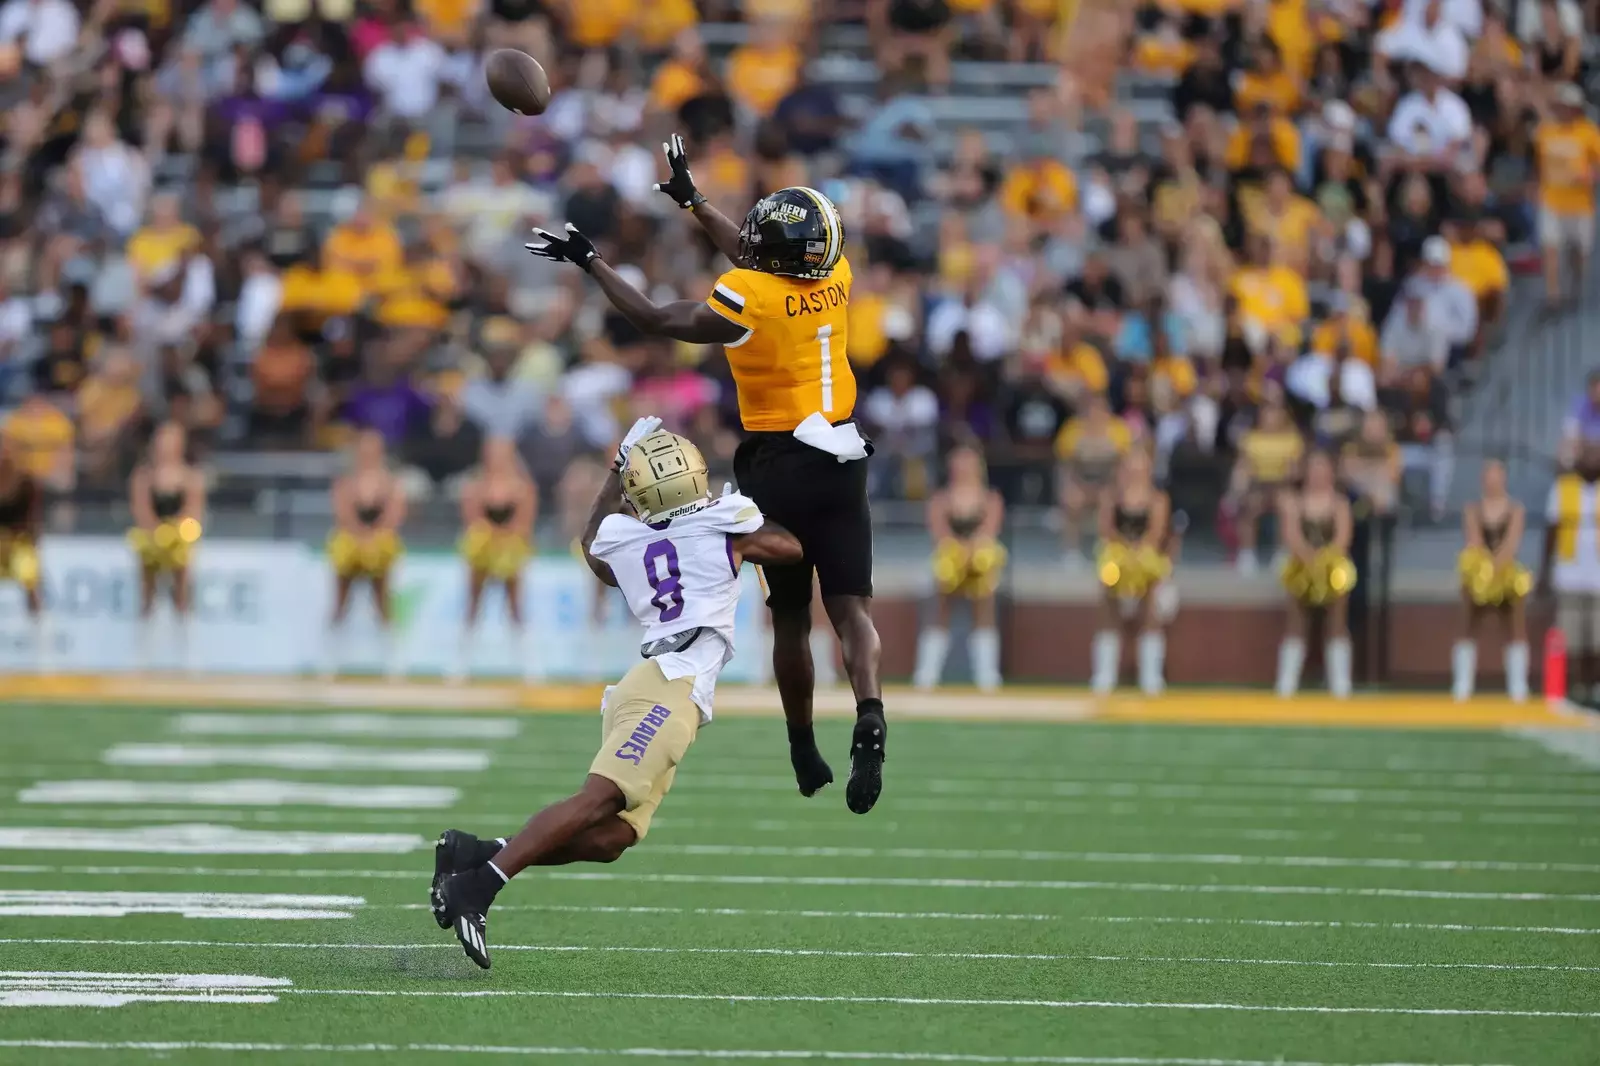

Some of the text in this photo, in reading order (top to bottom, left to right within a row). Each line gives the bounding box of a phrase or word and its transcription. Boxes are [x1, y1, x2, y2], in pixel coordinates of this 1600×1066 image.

[770, 211, 788, 222] MISS
[785, 281, 847, 317] CASTON
[816, 324, 833, 412] 1
[669, 503, 697, 518] schutt
[643, 538, 685, 623] 8
[614, 704, 672, 766] BRAVES
